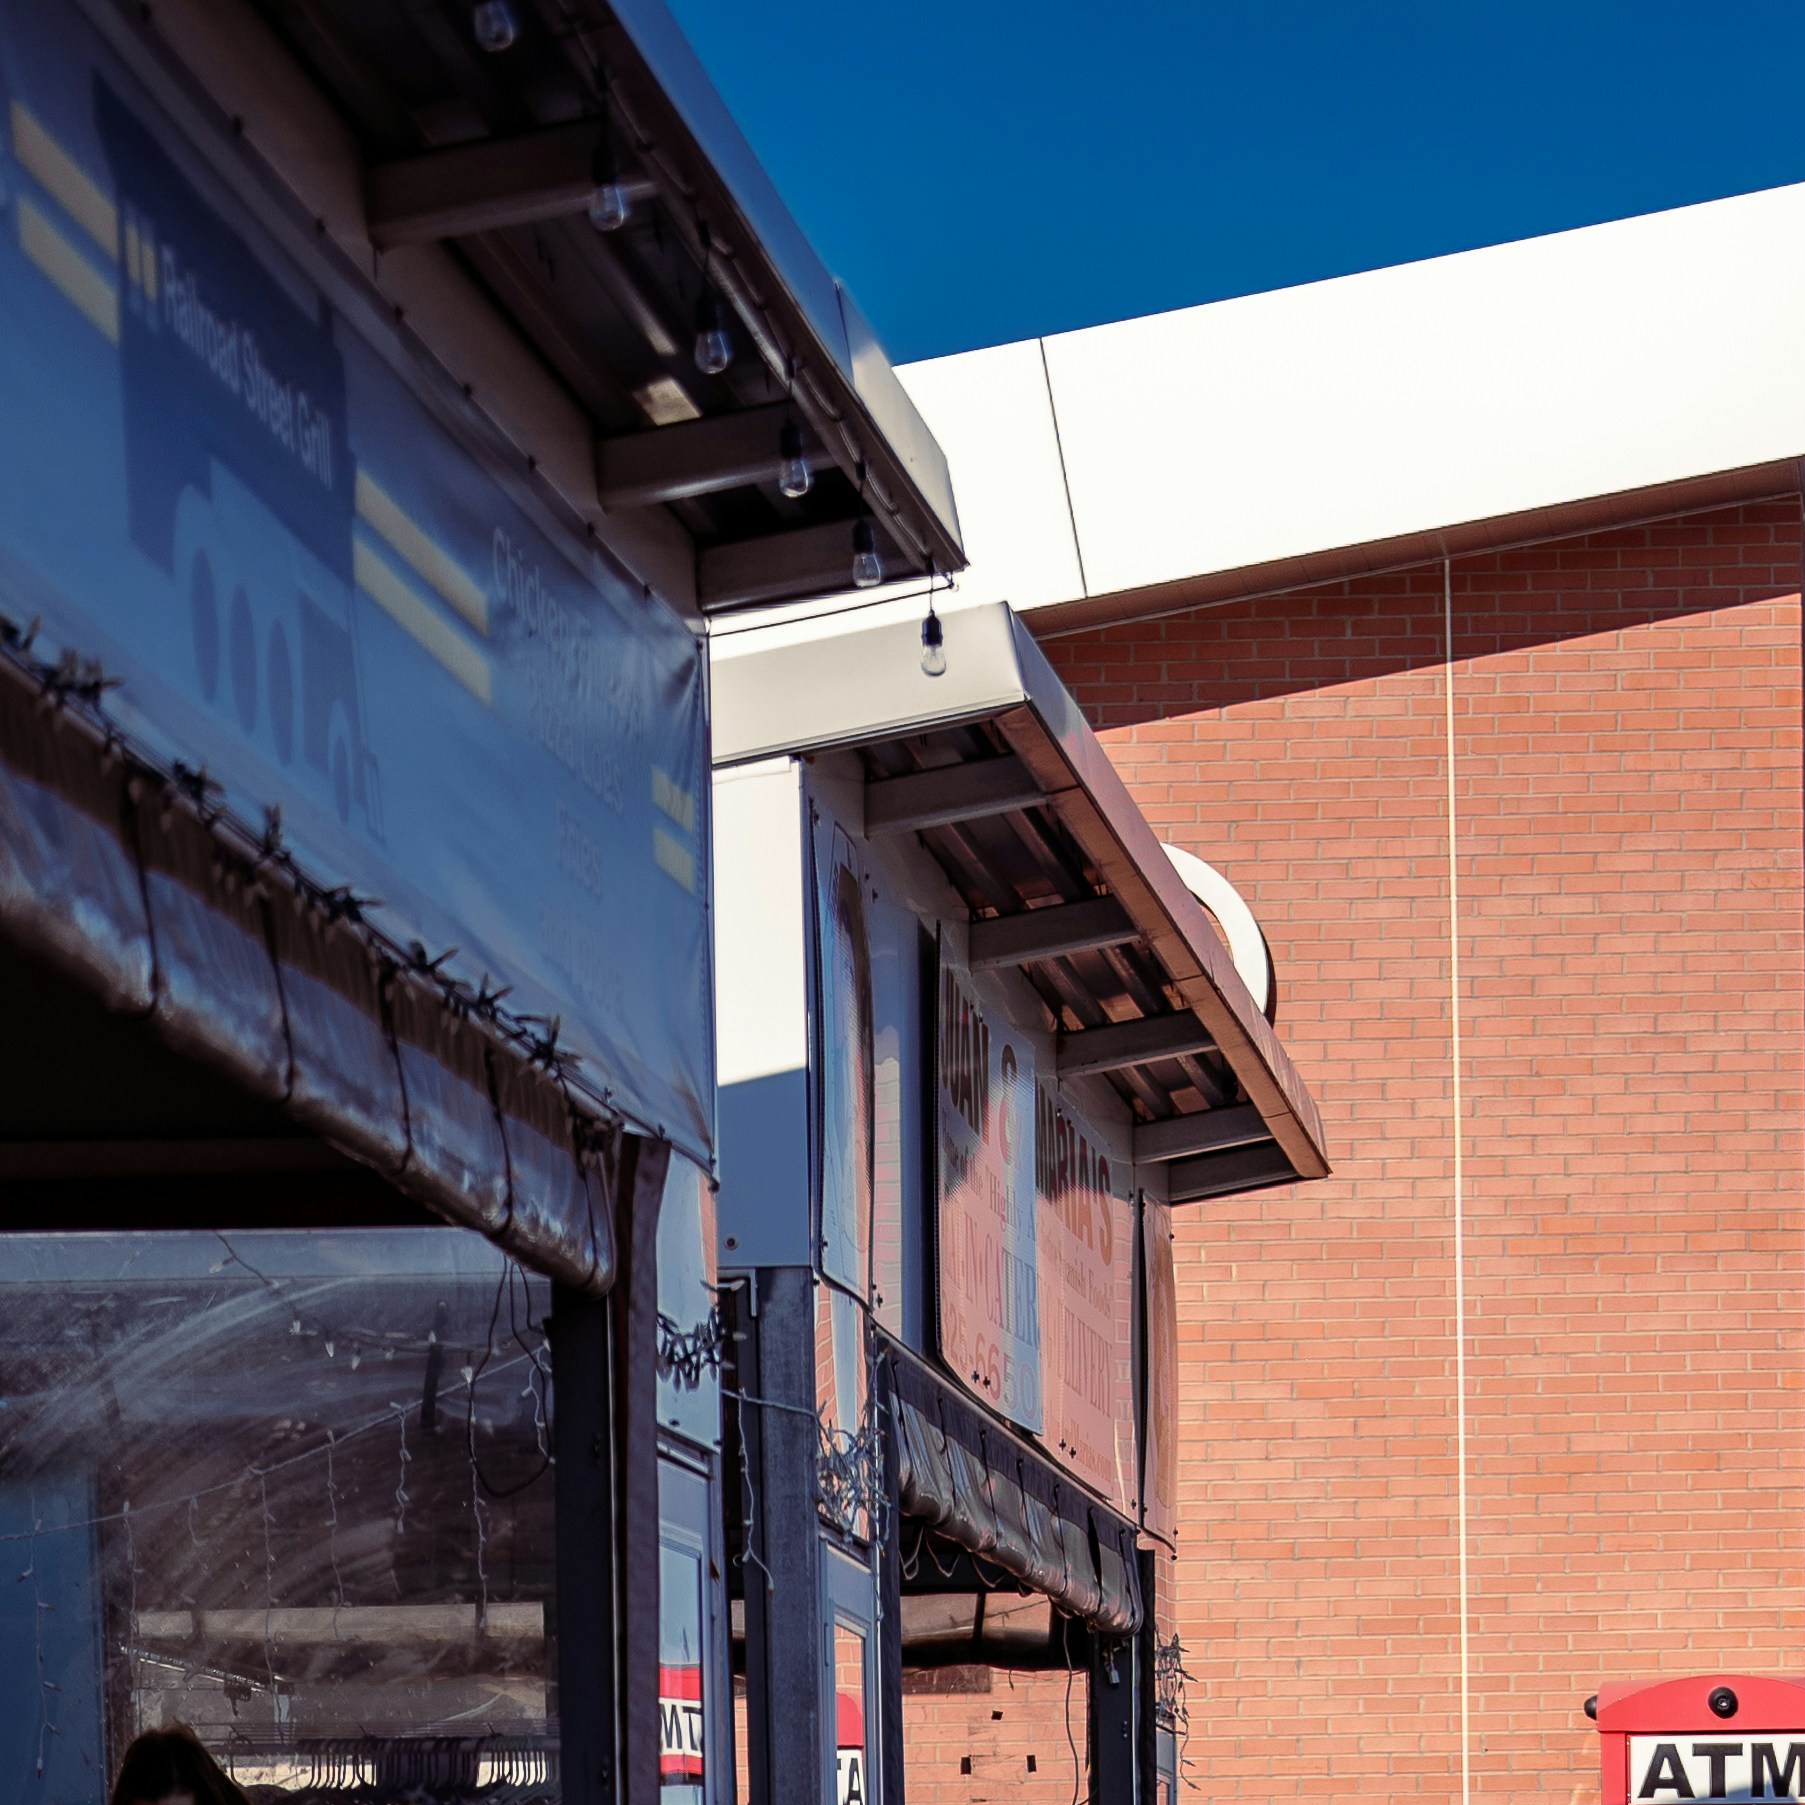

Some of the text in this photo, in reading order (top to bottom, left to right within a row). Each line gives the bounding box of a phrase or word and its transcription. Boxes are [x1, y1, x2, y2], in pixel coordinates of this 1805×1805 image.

[161, 243, 333, 491] Railroad Street Grill
[492, 526, 569, 656] Chicken
[556, 798, 602, 901] Fries
[941, 972, 989, 1146] JUAN
[998, 1044, 1023, 1177] &
[1035, 1076, 1113, 1266] MARIA'S
